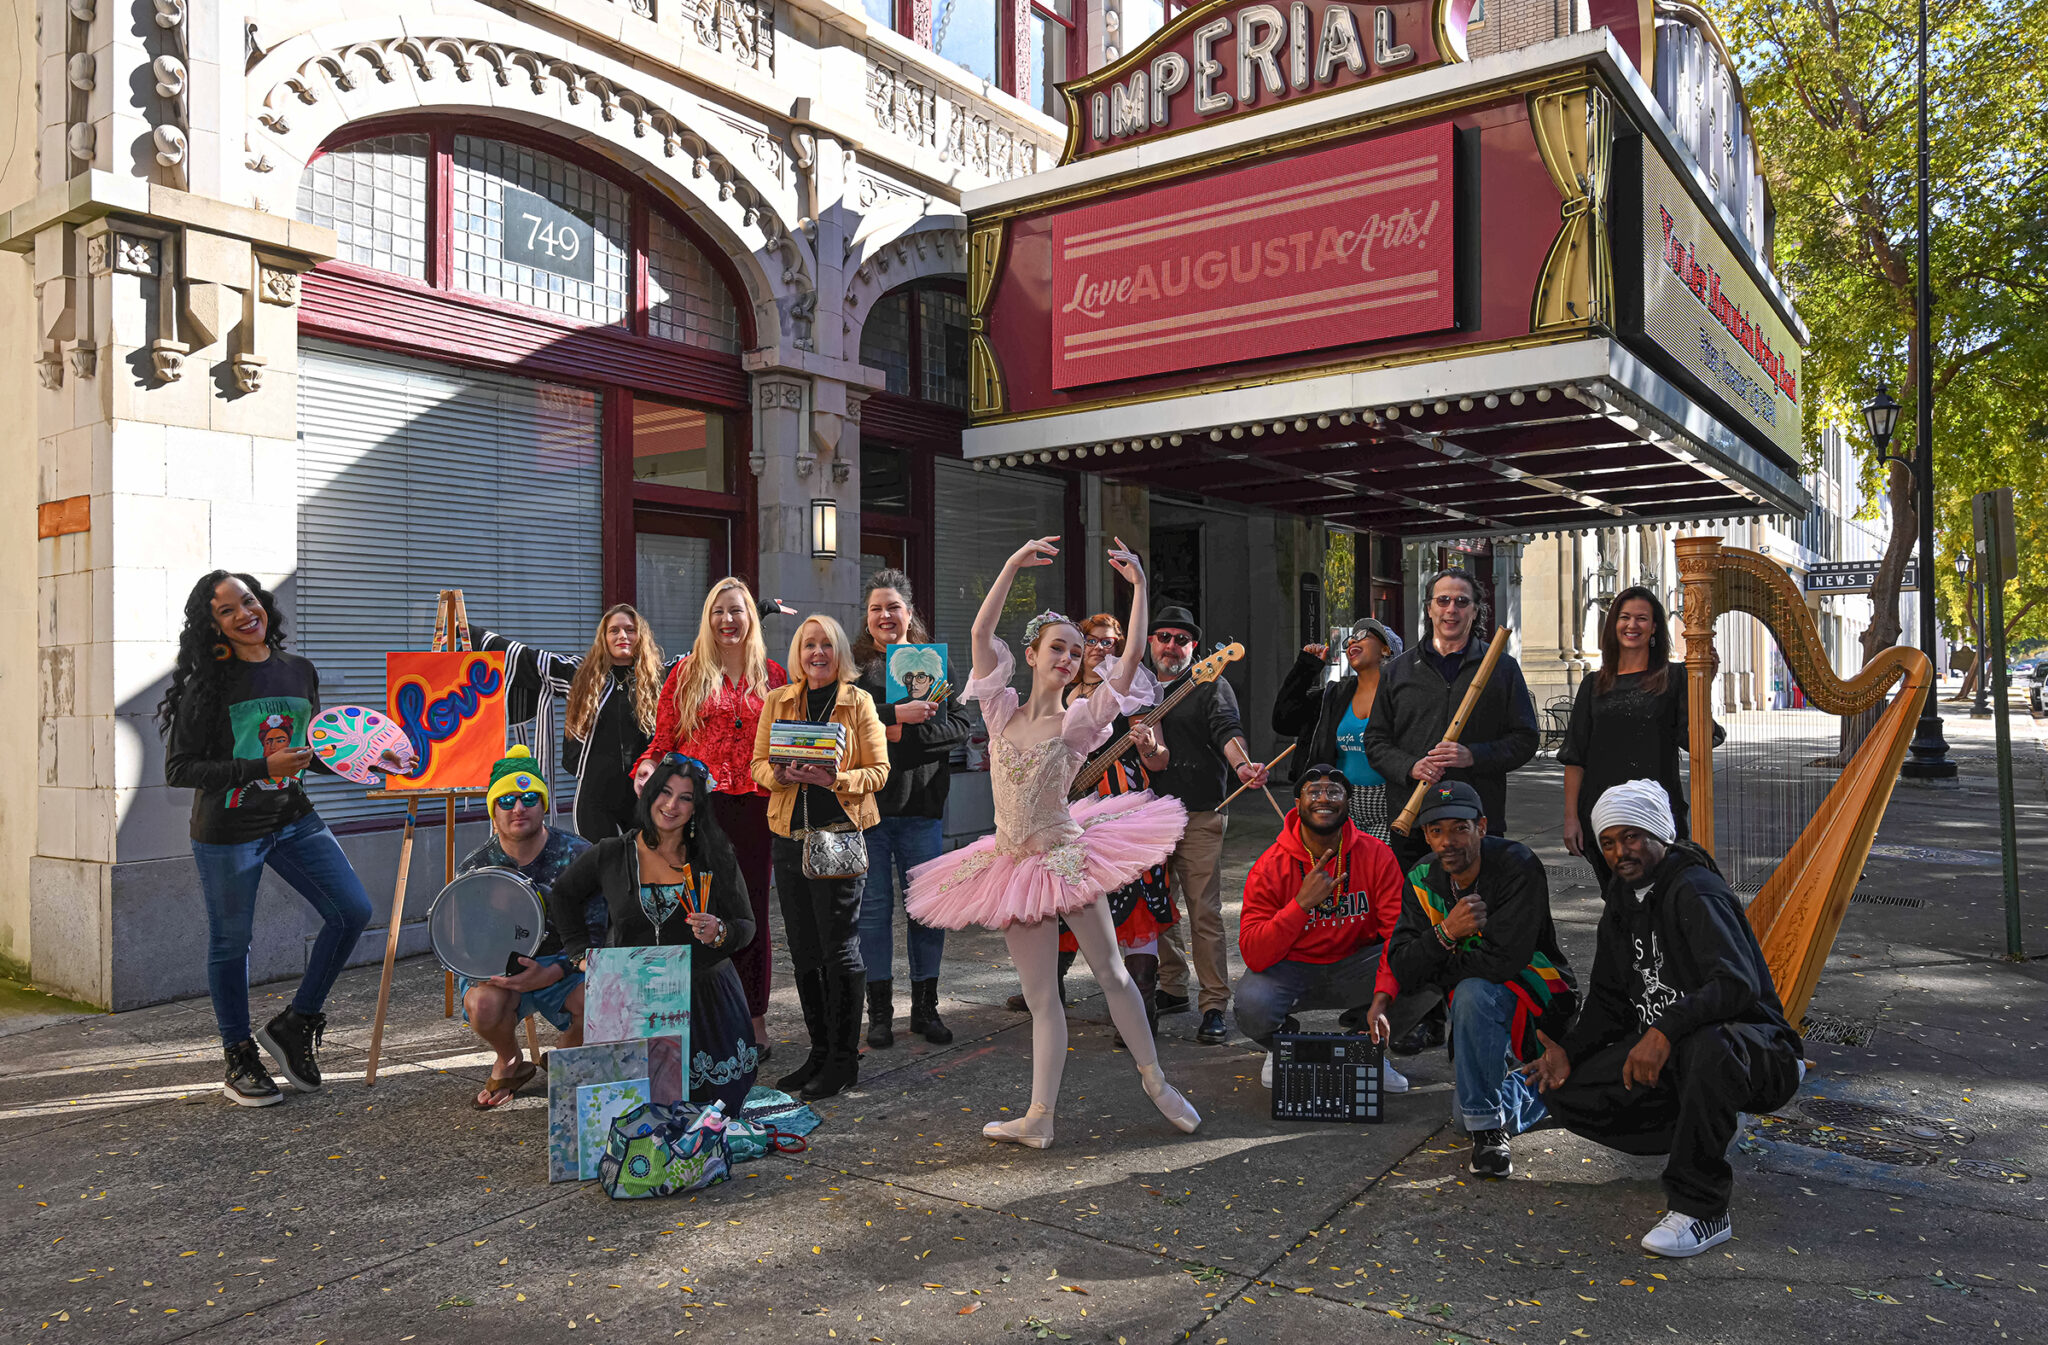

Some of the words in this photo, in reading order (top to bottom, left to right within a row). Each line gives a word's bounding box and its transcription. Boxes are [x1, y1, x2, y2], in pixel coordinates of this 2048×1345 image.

[1092, 2, 1415, 143] IMPERIAL
[522, 212, 580, 261] 749
[1063, 273, 1135, 318] Love
[1129, 226, 1347, 304] AUGUSTA
[1816, 575, 1855, 587] NEWS
